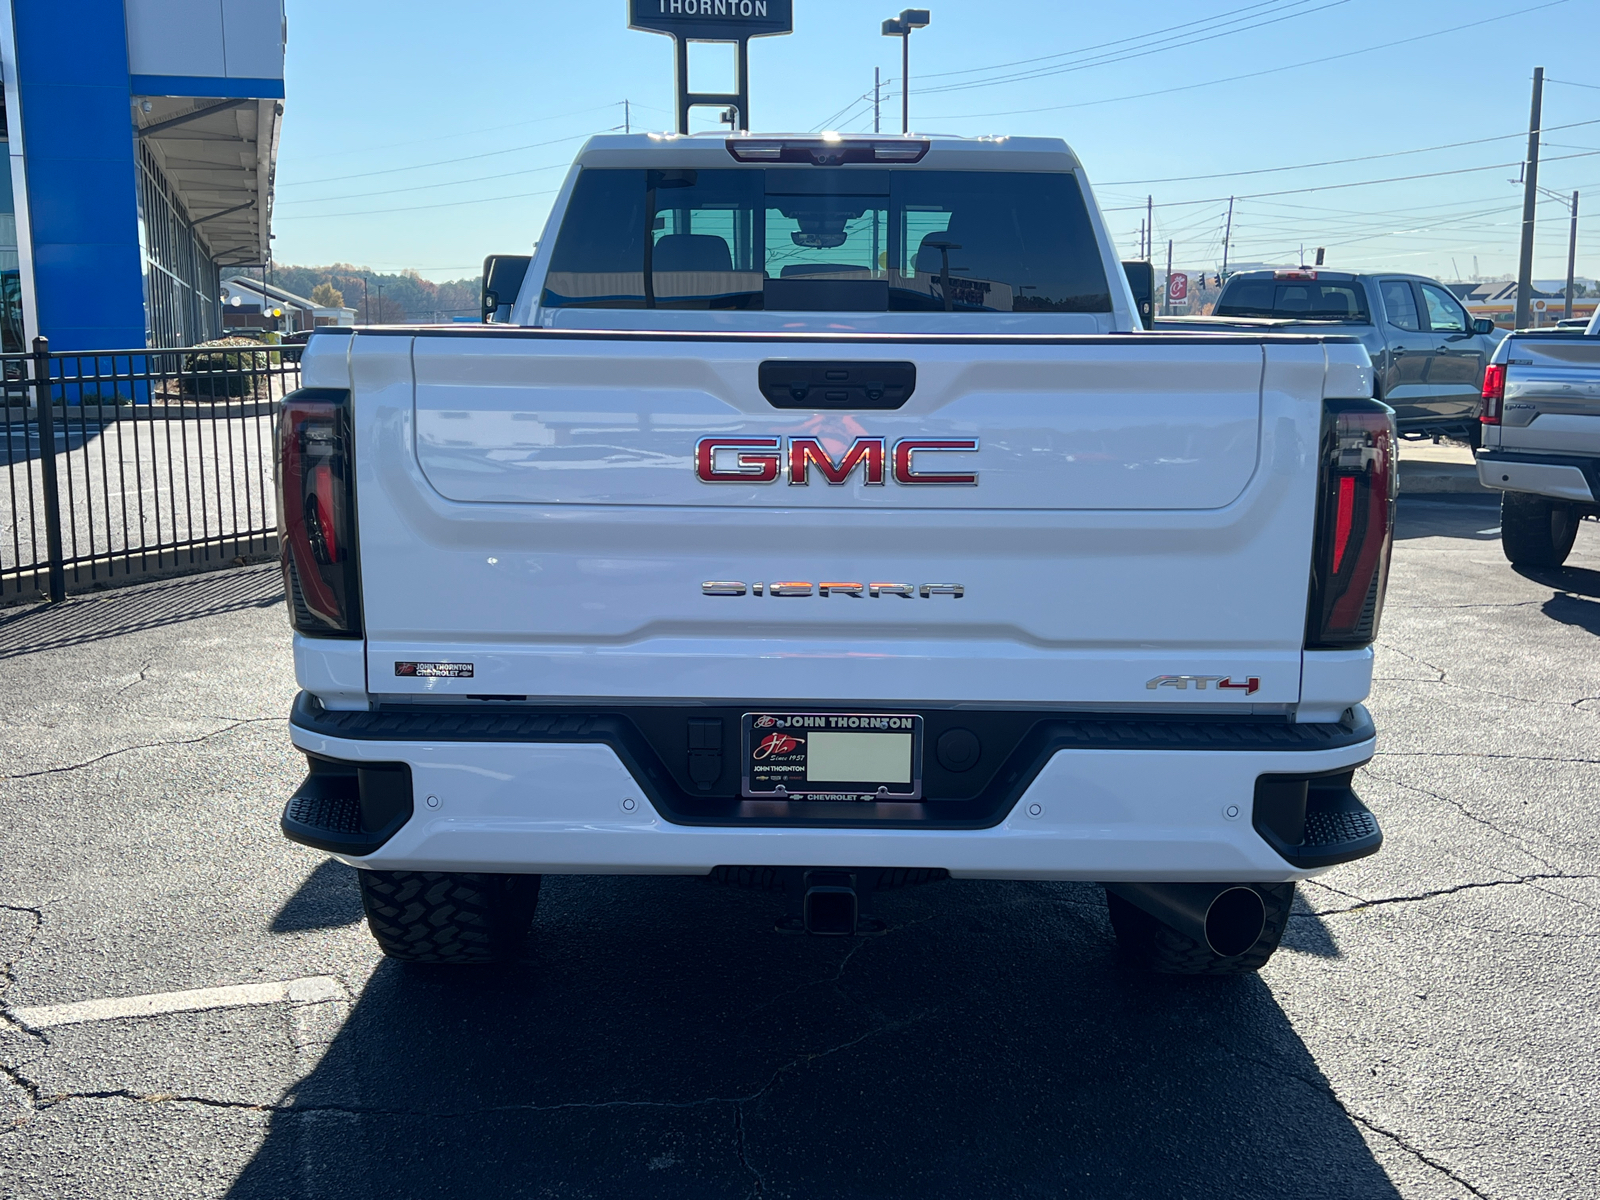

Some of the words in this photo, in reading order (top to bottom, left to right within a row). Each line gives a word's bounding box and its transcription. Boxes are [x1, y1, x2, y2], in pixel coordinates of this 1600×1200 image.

[659, 0, 767, 17] THORNTON
[694, 435, 980, 487] GMC
[701, 581, 965, 600] SIERRA
[416, 663, 434, 671] JOHN
[435, 663, 472, 671] THORNTON
[1146, 674, 1261, 696] AT4
[784, 716, 826, 727] JOHN
[829, 717, 912, 729] THORNTON
